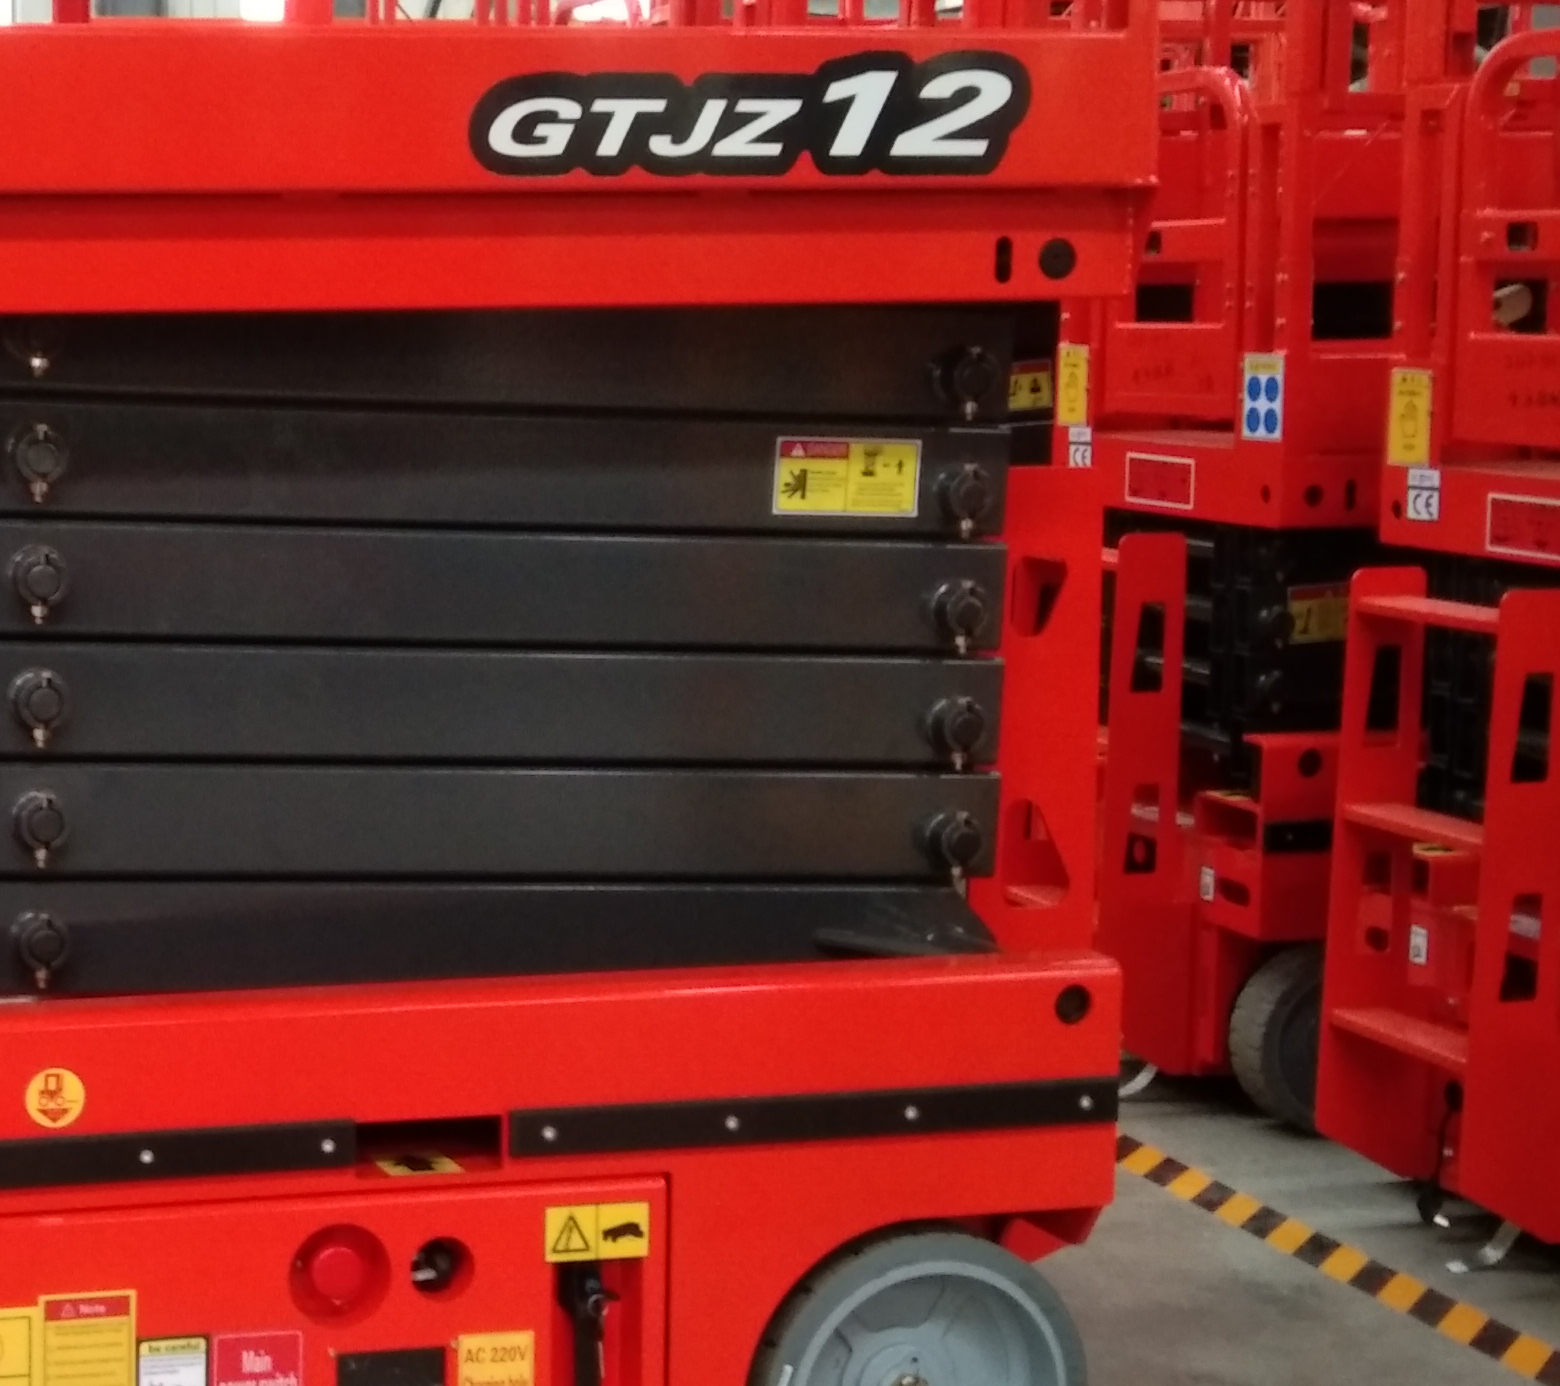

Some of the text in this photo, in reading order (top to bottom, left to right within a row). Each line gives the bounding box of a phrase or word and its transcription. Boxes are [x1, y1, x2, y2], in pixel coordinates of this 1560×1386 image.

[487, 69, 1013, 158] GTJZ12
[241, 1349, 273, 1374] Main
[464, 1344, 528, 1364] AC 220V
